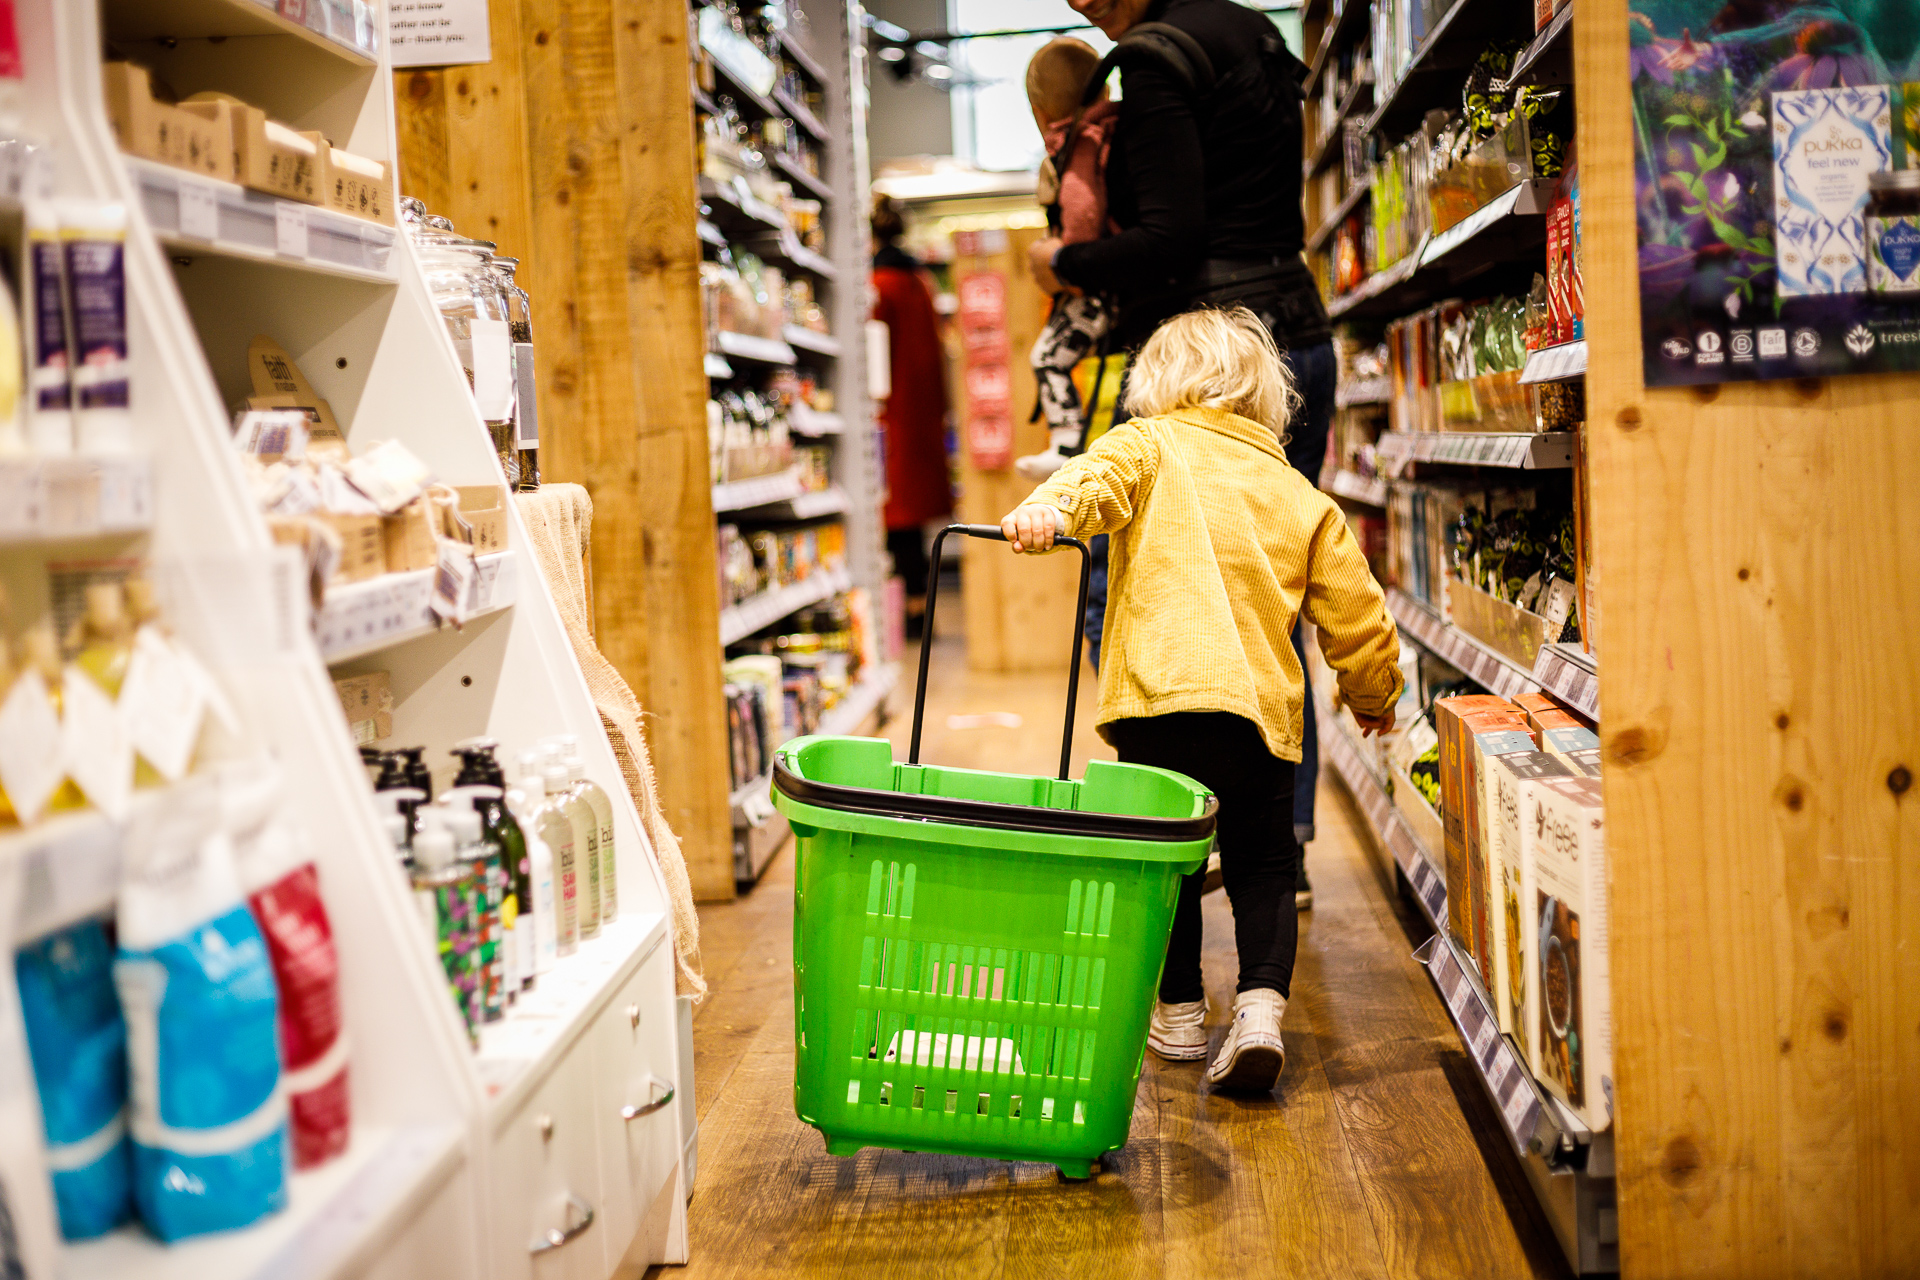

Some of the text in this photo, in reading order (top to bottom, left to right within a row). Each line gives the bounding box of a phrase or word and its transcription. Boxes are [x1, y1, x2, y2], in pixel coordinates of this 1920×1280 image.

[1804, 137, 1863, 157] pukka
[1808, 157, 1861, 169] feel new
[1762, 331, 1784, 346] fair
[261, 353, 294, 381] faith
[1546, 807, 1579, 863] freee
